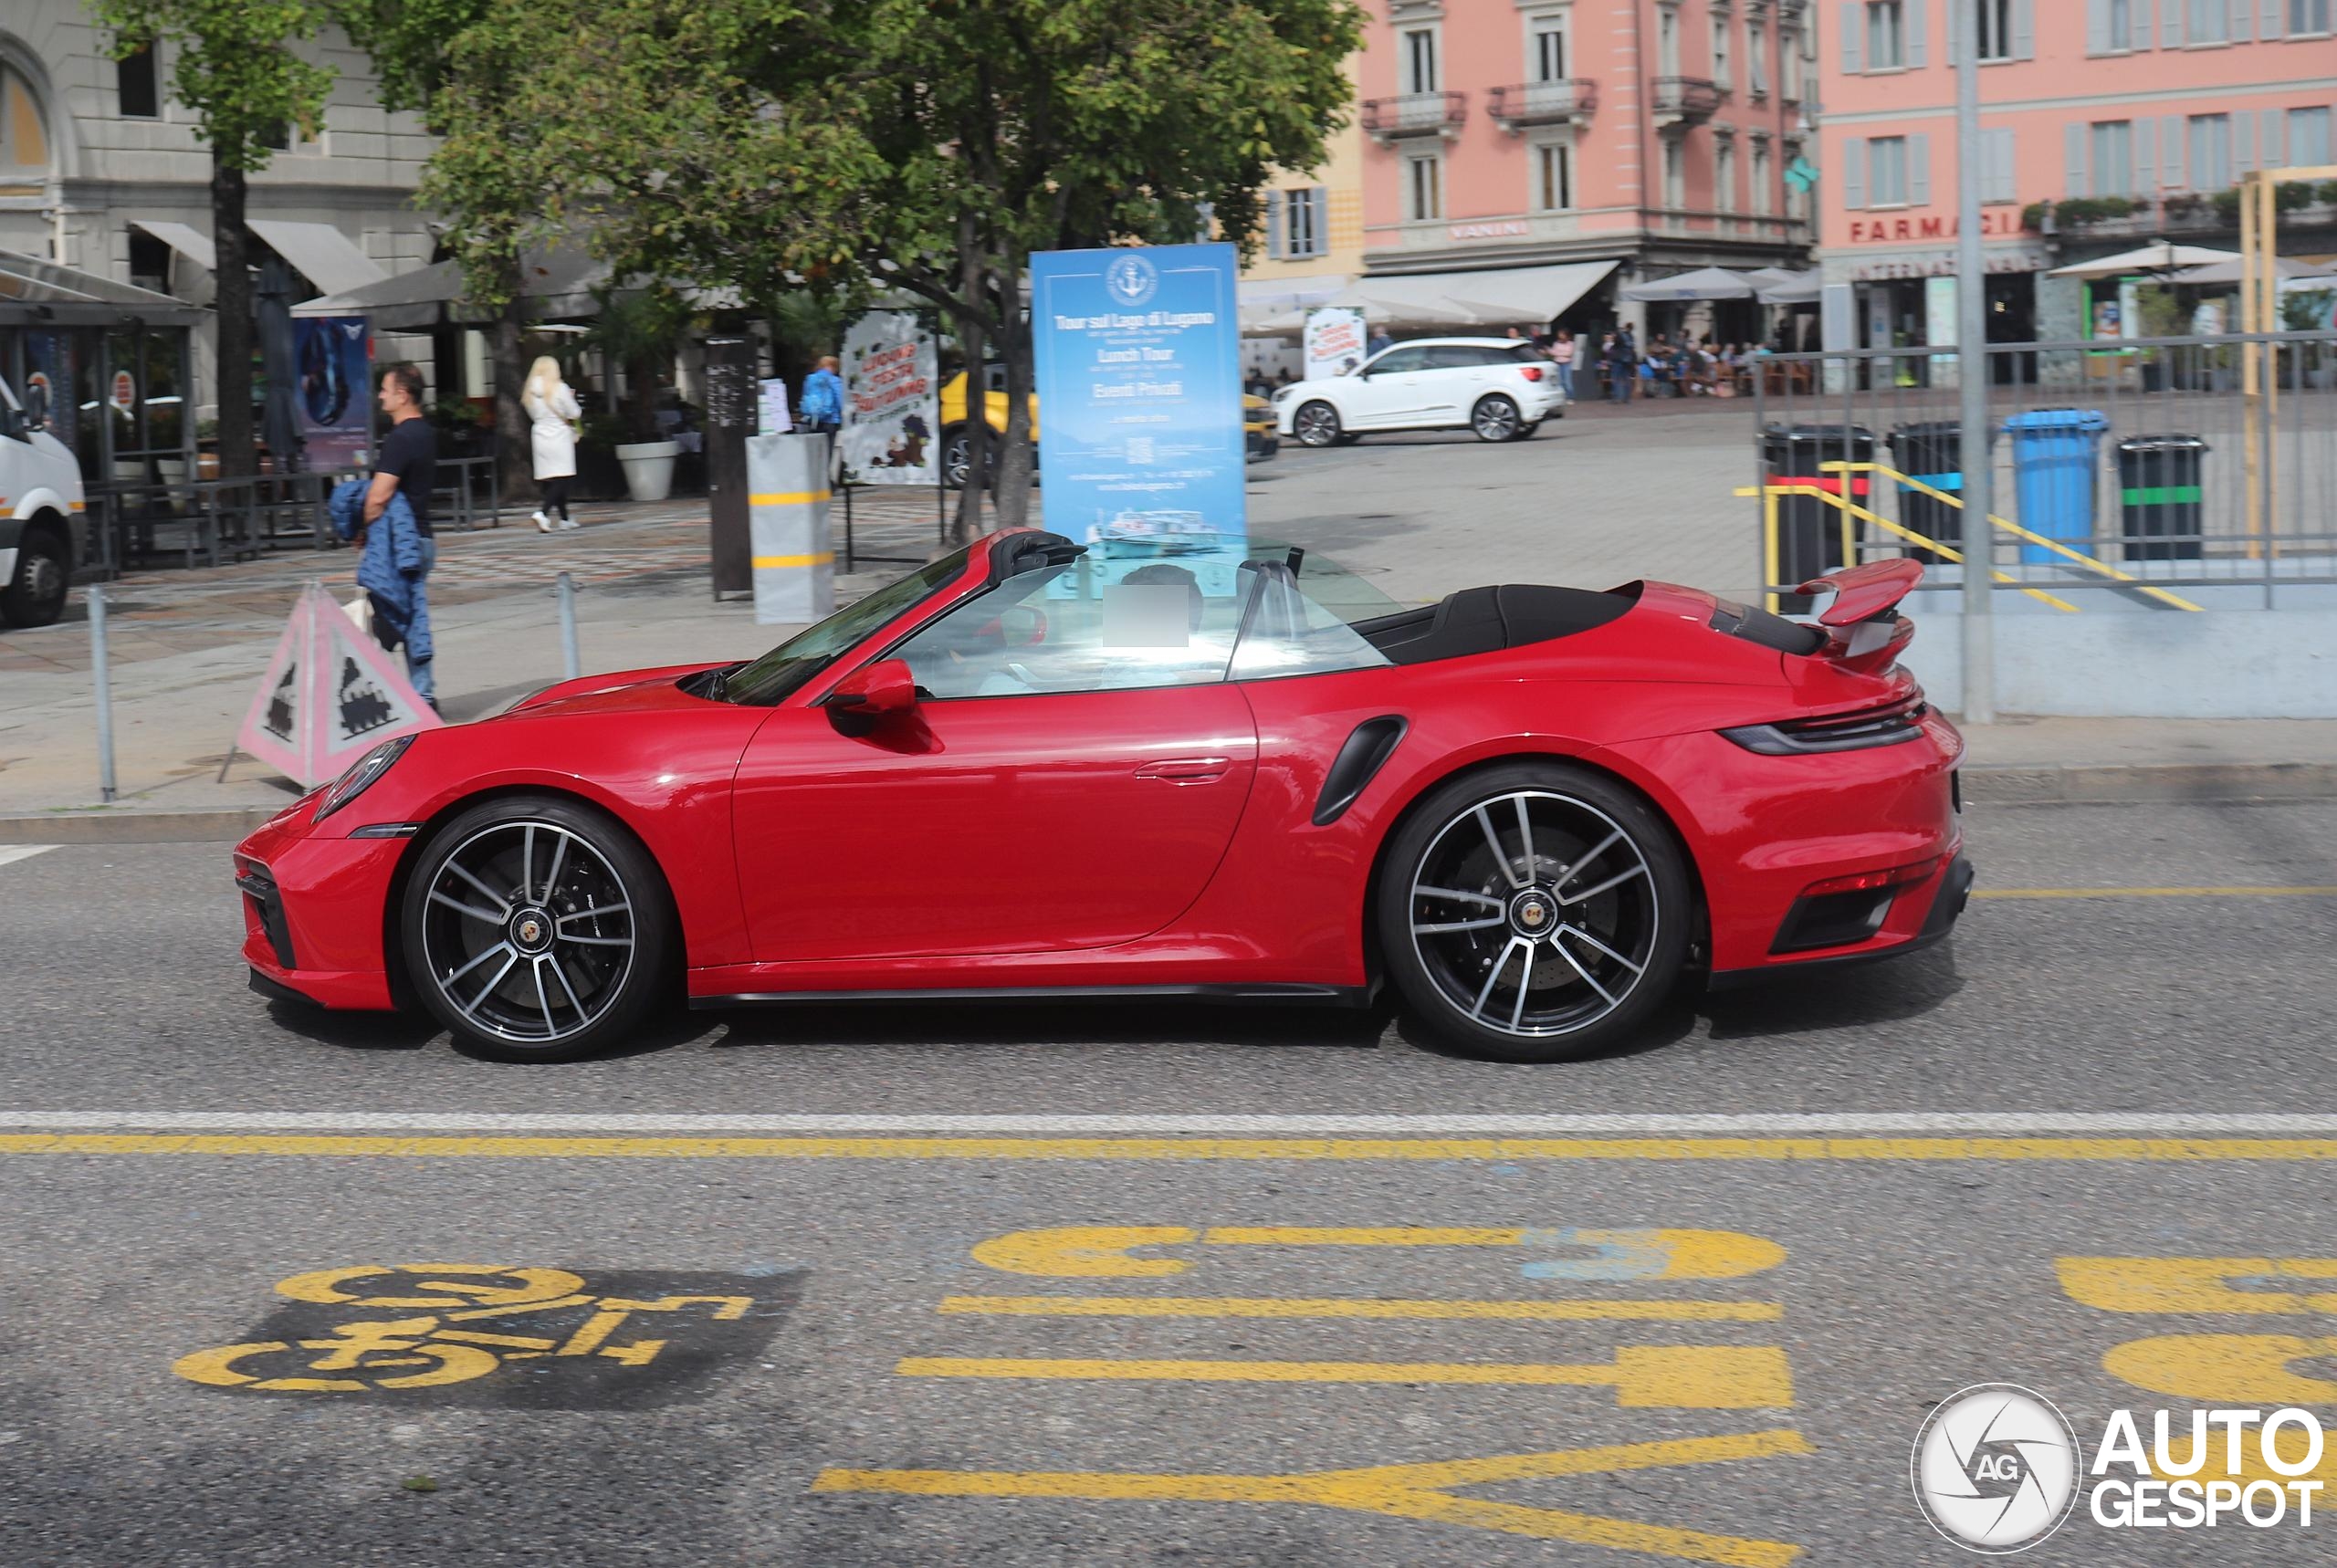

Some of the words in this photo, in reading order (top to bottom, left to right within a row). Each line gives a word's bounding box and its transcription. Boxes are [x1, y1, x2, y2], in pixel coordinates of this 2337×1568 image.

[1054, 315, 1086, 329] Tour
[1088, 313, 1111, 329] sul
[1112, 313, 1145, 329] Lago
[1148, 311, 1162, 327] di
[1163, 311, 1215, 328] Lugano
[1097, 349, 1140, 363] Lunch
[1141, 347, 1175, 361] Tour
[1092, 382, 1135, 398] Eventi
[1137, 381, 1183, 396] Privati
[587, 894, 602, 938] POCHE
